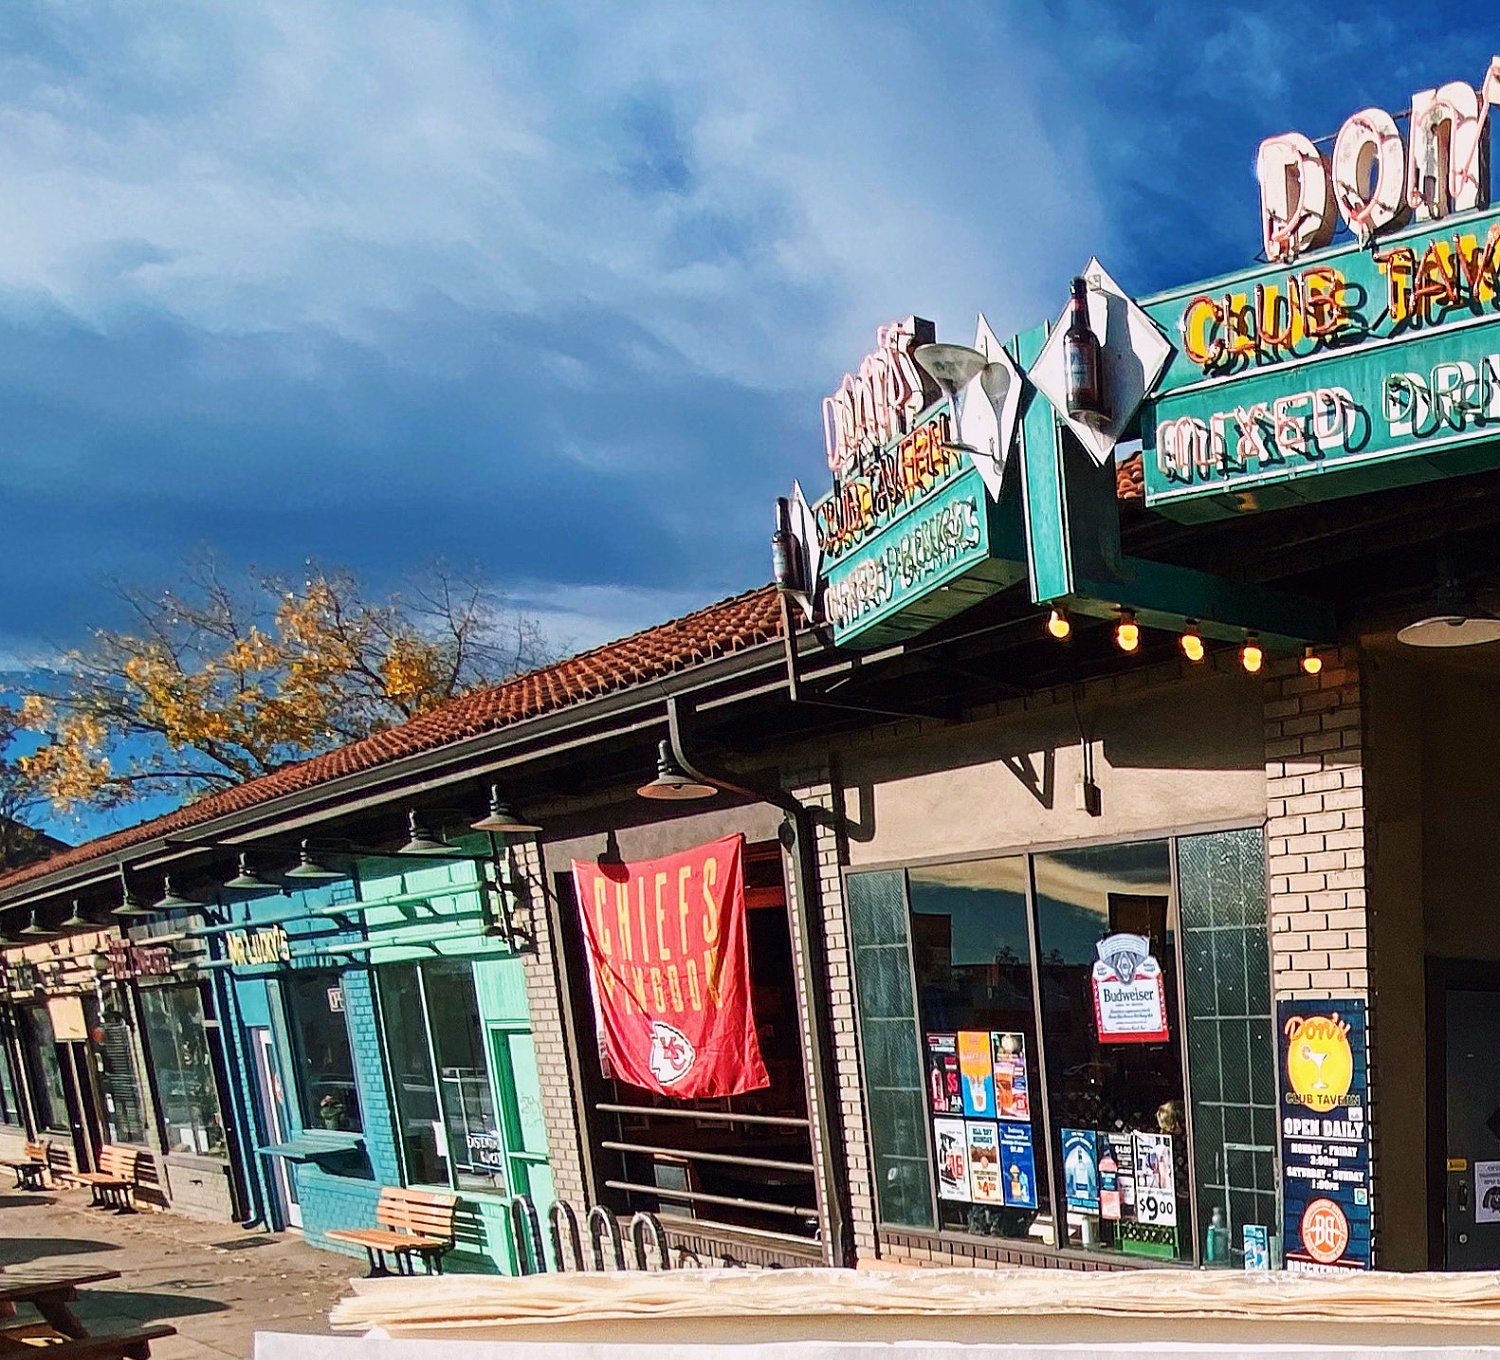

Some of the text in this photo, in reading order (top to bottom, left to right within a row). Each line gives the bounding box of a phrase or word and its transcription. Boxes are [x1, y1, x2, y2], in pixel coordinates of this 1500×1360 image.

[1183, 266, 1351, 366] CLUB
[1155, 385, 1355, 478] MIXED
[594, 857, 718, 963] CHIEFS
[1103, 987, 1154, 1002] Budweiser
[1285, 1012, 1351, 1041] Don's
[1285, 1092, 1360, 1107] CLUB TAVERN
[1284, 1118, 1364, 1138] OPEN DAILY
